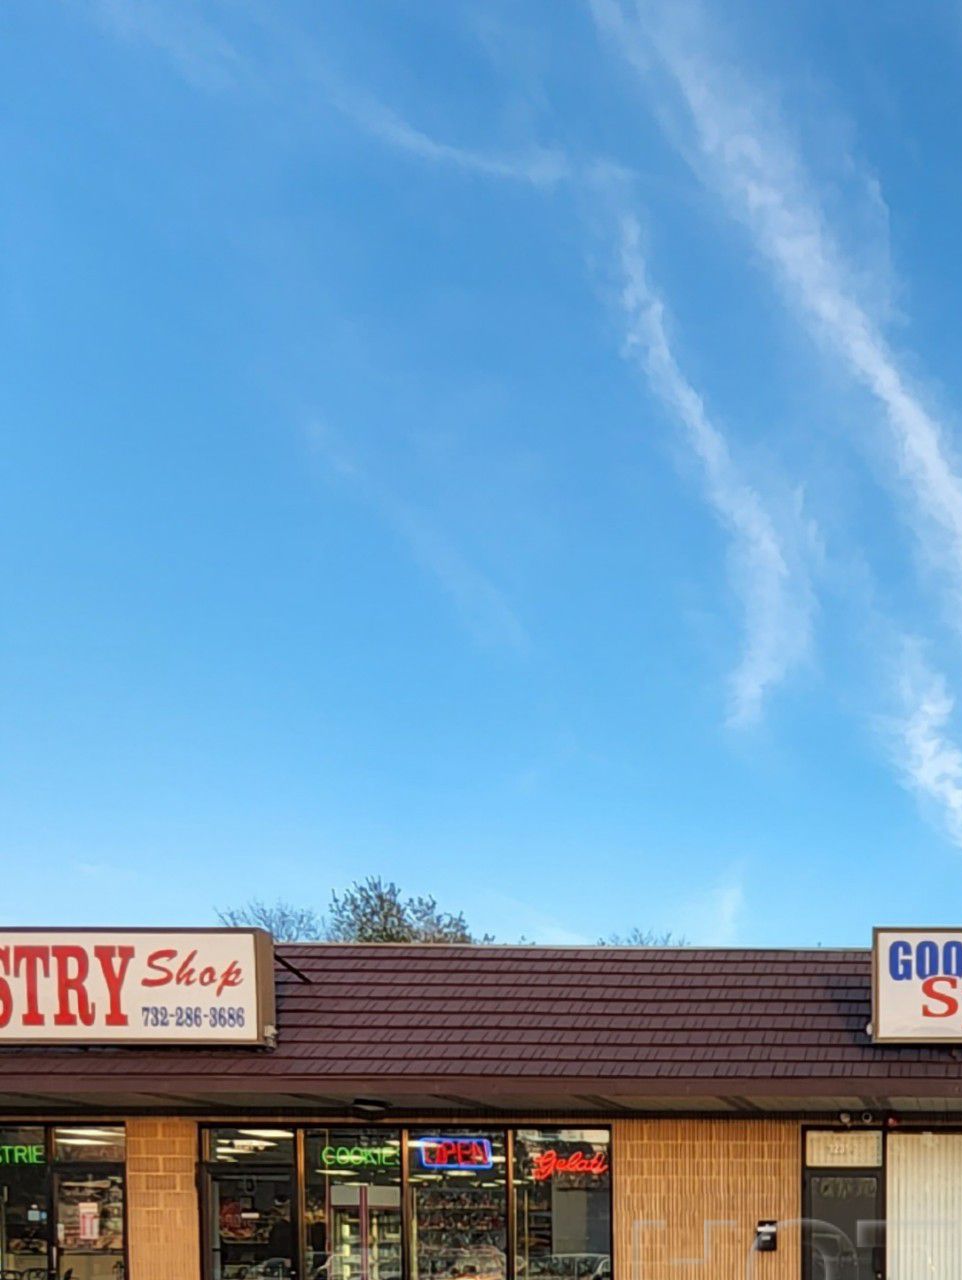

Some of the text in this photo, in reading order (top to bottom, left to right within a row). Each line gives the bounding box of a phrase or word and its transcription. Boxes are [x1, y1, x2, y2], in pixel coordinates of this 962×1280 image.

[141, 949, 243, 997] Shop
[142, 1006, 245, 1028] 732-286-3686
[0, 1144, 46, 1164] TRIE
[424, 1140, 489, 1165] OPEN
